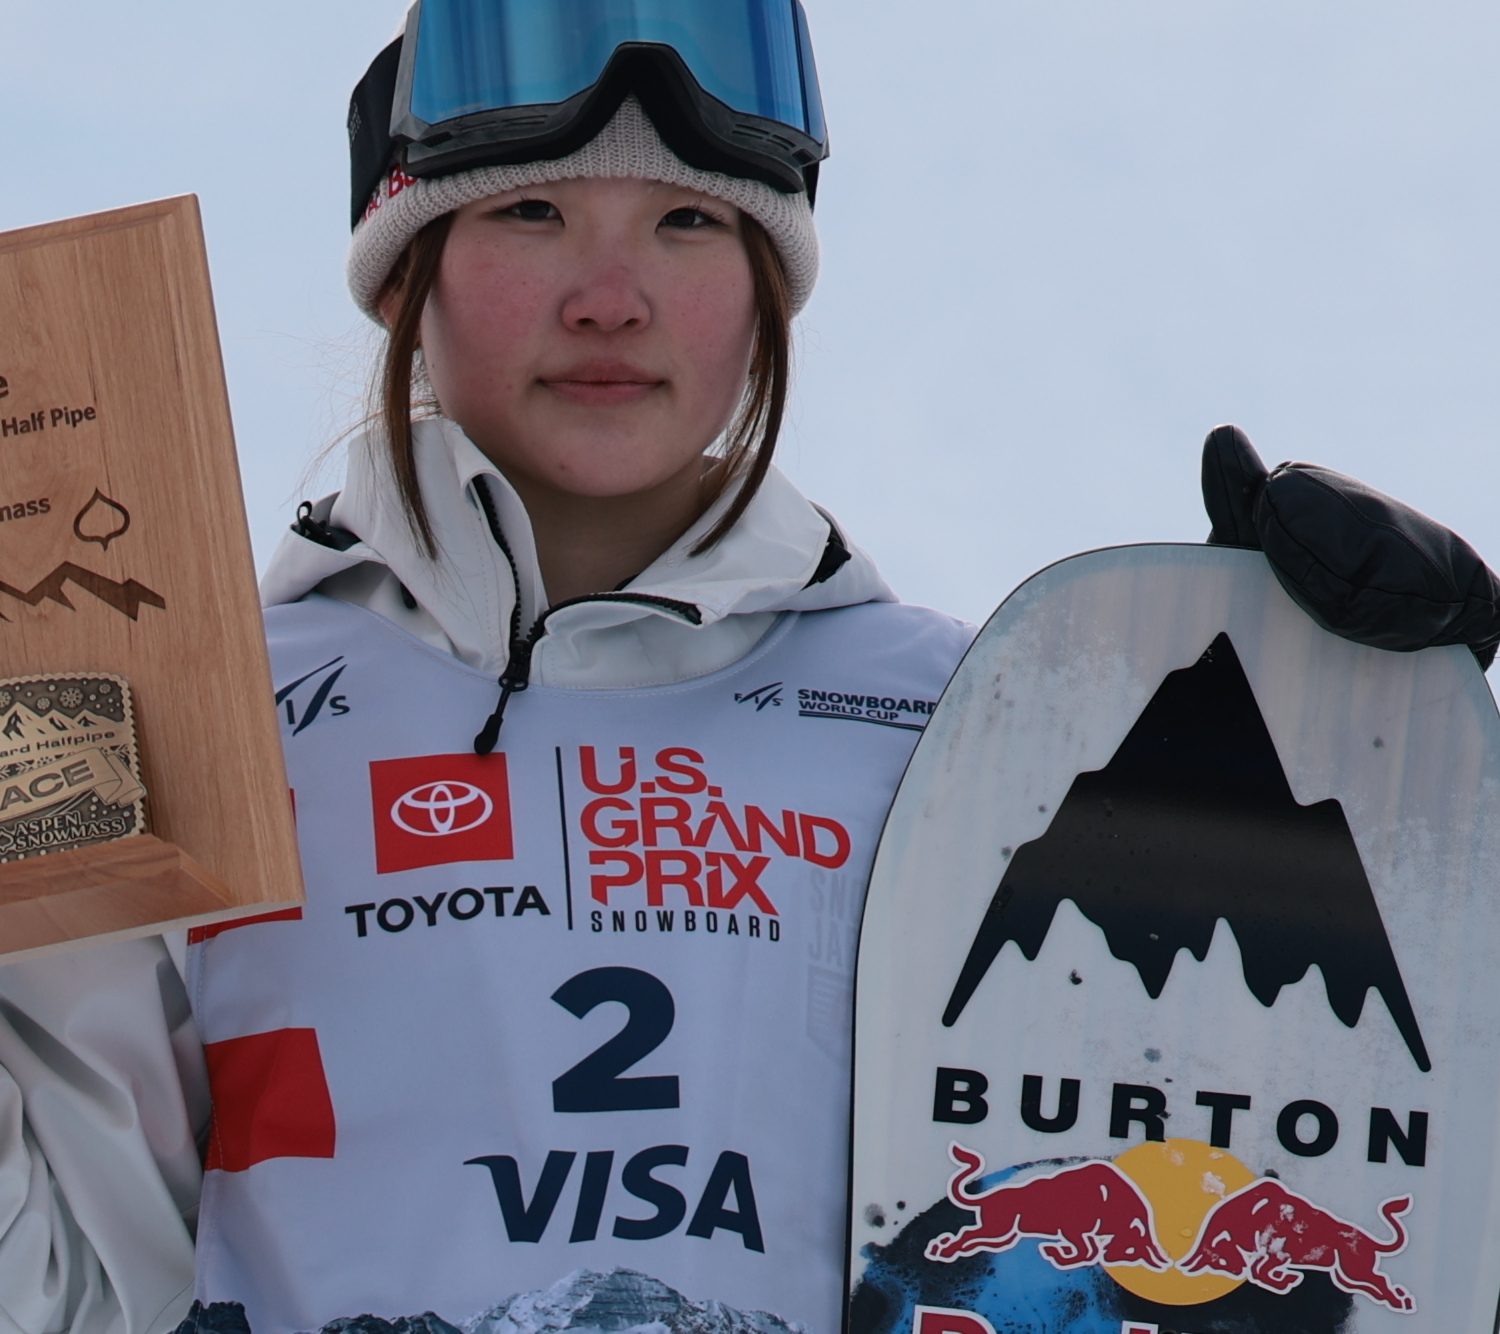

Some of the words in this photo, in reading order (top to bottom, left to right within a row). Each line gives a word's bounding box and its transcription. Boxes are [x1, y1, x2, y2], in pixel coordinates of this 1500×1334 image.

[2, 411, 46, 439] Half
[51, 405, 97, 429] Pipe
[799, 700, 862, 716] WORLD
[866, 709, 899, 721] CUP
[36, 729, 116, 751] Halfpipe
[578, 745, 723, 797] U.S.
[15, 813, 80, 836] ASPEN
[15, 819, 124, 850] SNOWMASS
[580, 796, 851, 870] GRAND
[589, 849, 780, 917] PRIX
[345, 884, 551, 938] TOYOTA
[590, 909, 781, 943] SNOWBOARD
[550, 966, 680, 1113] 2
[932, 1066, 1430, 1168] BURTON
[462, 1144, 766, 1255] VISA
